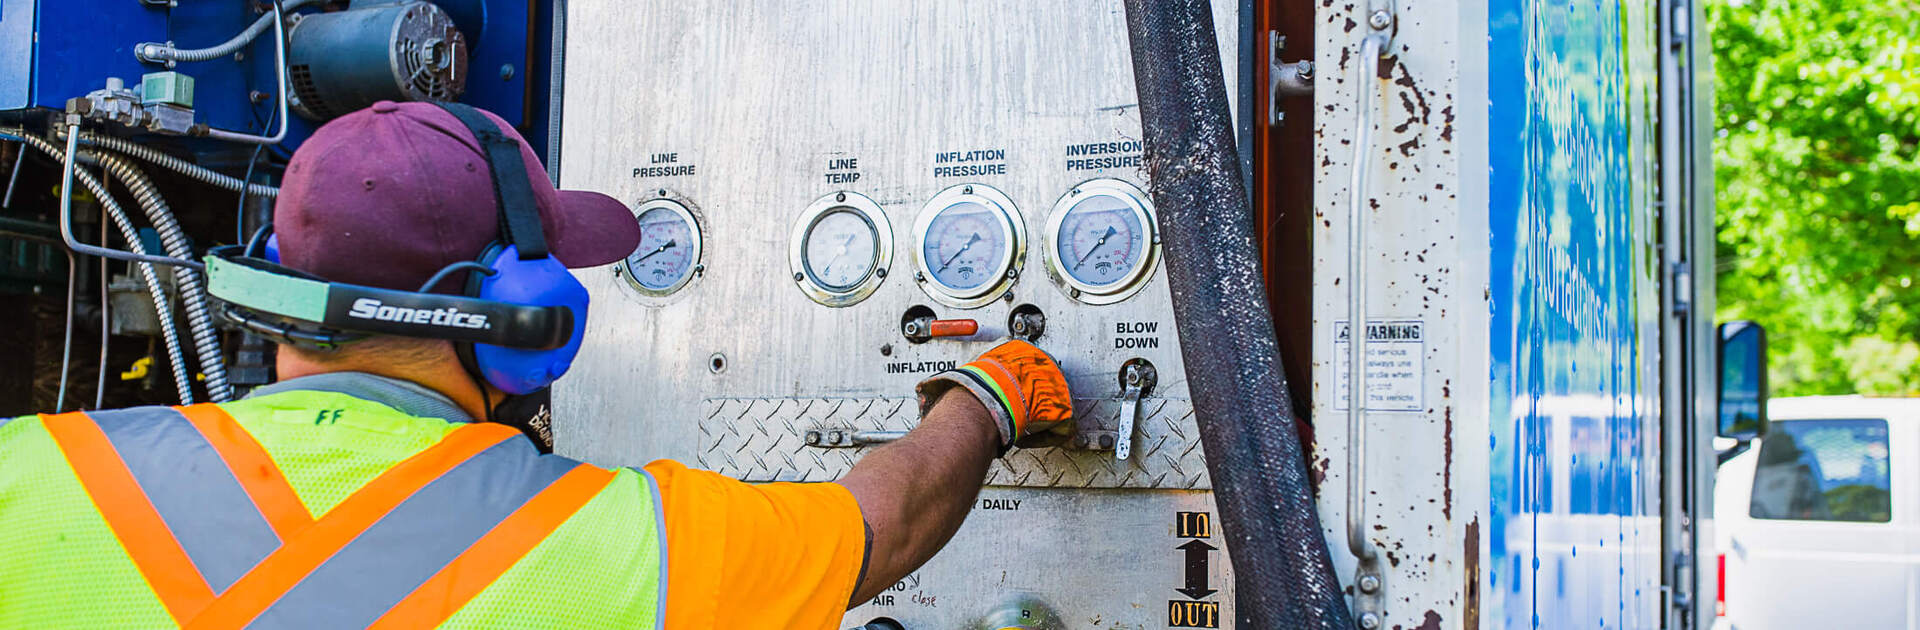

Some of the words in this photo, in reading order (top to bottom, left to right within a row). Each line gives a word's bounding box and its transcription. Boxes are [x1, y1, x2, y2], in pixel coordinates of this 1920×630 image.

[1066, 141, 1142, 156] INVERSION
[651, 153, 678, 164] LINE
[935, 149, 1005, 163] INFLATION
[828, 158, 858, 171] LINE
[1066, 155, 1142, 171] PRESSURE
[632, 165, 696, 178] PRESSURE
[934, 164, 1006, 178] PRESSURE
[825, 172, 861, 184] TEMP
[1116, 322, 1158, 334] BLOW
[1115, 337, 1159, 349] DOWN
[887, 361, 956, 374] INFLATION
[983, 499, 1021, 510] DAILY
[872, 595, 895, 606] AIR
[1171, 602, 1217, 627] OUT
